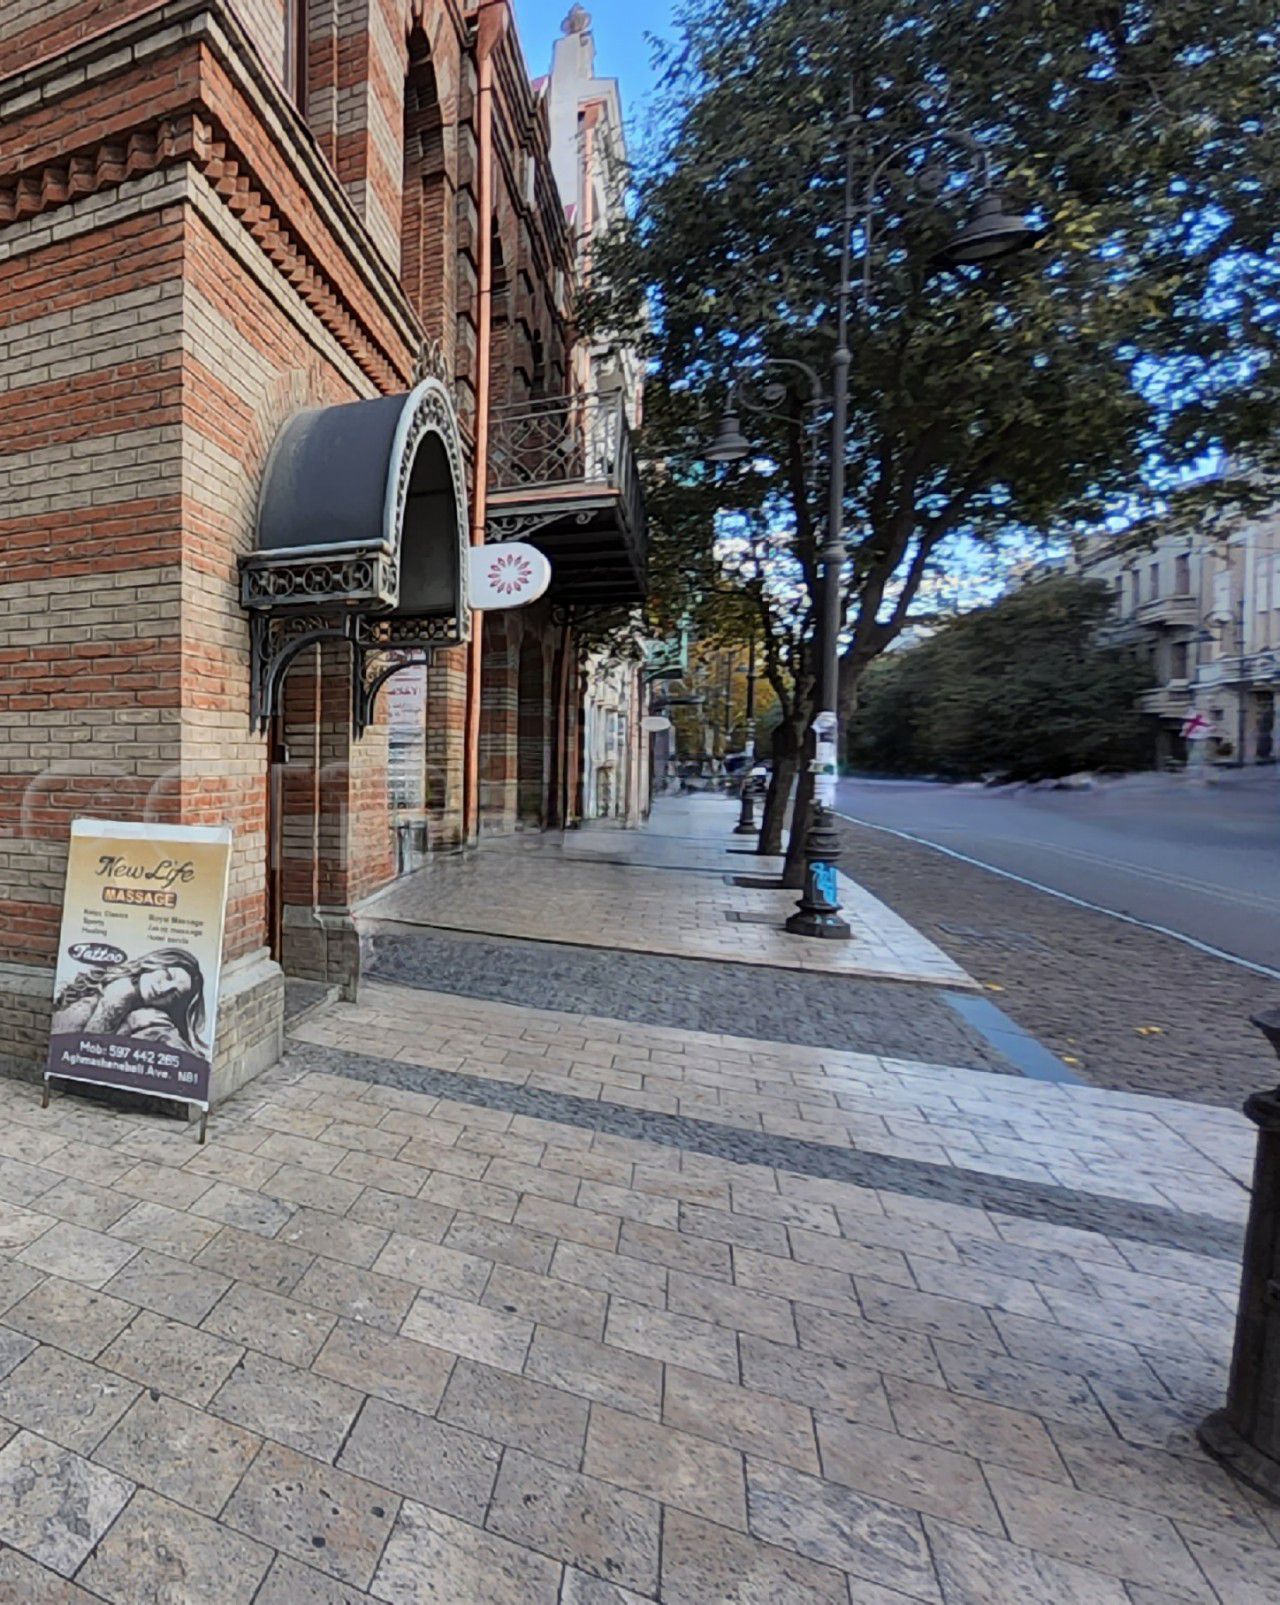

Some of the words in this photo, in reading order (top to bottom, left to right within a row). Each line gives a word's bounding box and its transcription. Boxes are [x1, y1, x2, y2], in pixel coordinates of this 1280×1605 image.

[95, 855, 144, 880] New
[145, 860, 195, 888] Life
[104, 888, 175, 907] MASSAGE
[73, 945, 123, 963] Tattoo
[108, 1045, 131, 1058] 597
[132, 1050, 155, 1064] 442
